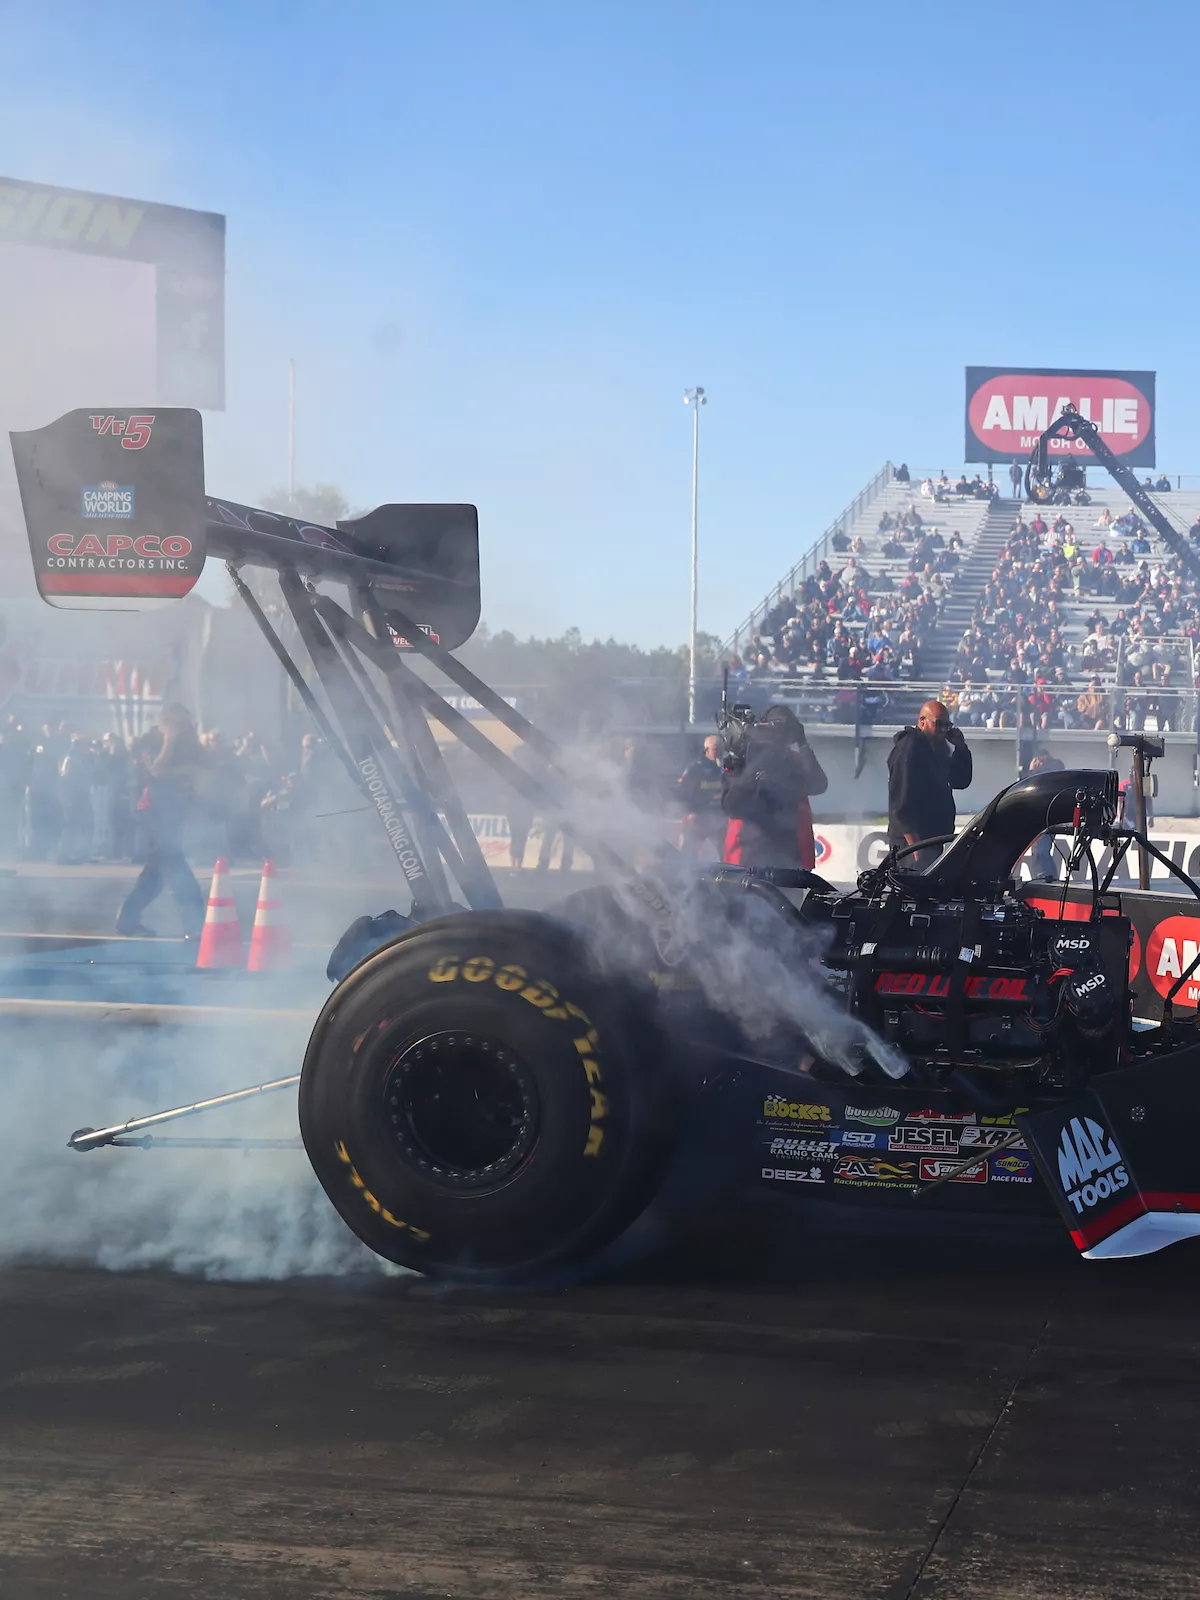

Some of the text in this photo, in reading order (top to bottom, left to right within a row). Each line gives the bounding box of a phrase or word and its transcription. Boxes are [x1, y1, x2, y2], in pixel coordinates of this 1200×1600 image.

[982, 395, 1138, 434] AMALIE
[1021, 436, 1070, 449] MOOR
[83, 491, 132, 501] CAMPING
[84, 501, 132, 513] WORLD
[47, 533, 192, 558] CAPCO
[47, 558, 188, 570] CONTRACTORS INC.
[358, 755, 424, 881] TOYOTARACING.COM
[1056, 939, 1090, 949] MSD
[874, 973, 1029, 999] RED LIE OIL
[1075, 974, 1107, 997] MSD
[890, 1128, 957, 1145] JESEL
[770, 1149, 839, 1160] RACING CAMS
[1058, 1117, 1122, 1192] MAC
[996, 1160, 1029, 1168] SUNOCO
[762, 1168, 810, 1181] DEEZ
[991, 1175, 1033, 1184] RACE FUELS
[833, 1178, 918, 1189] RacingSprings.com
[1067, 1165, 1130, 1214] TOOLS
